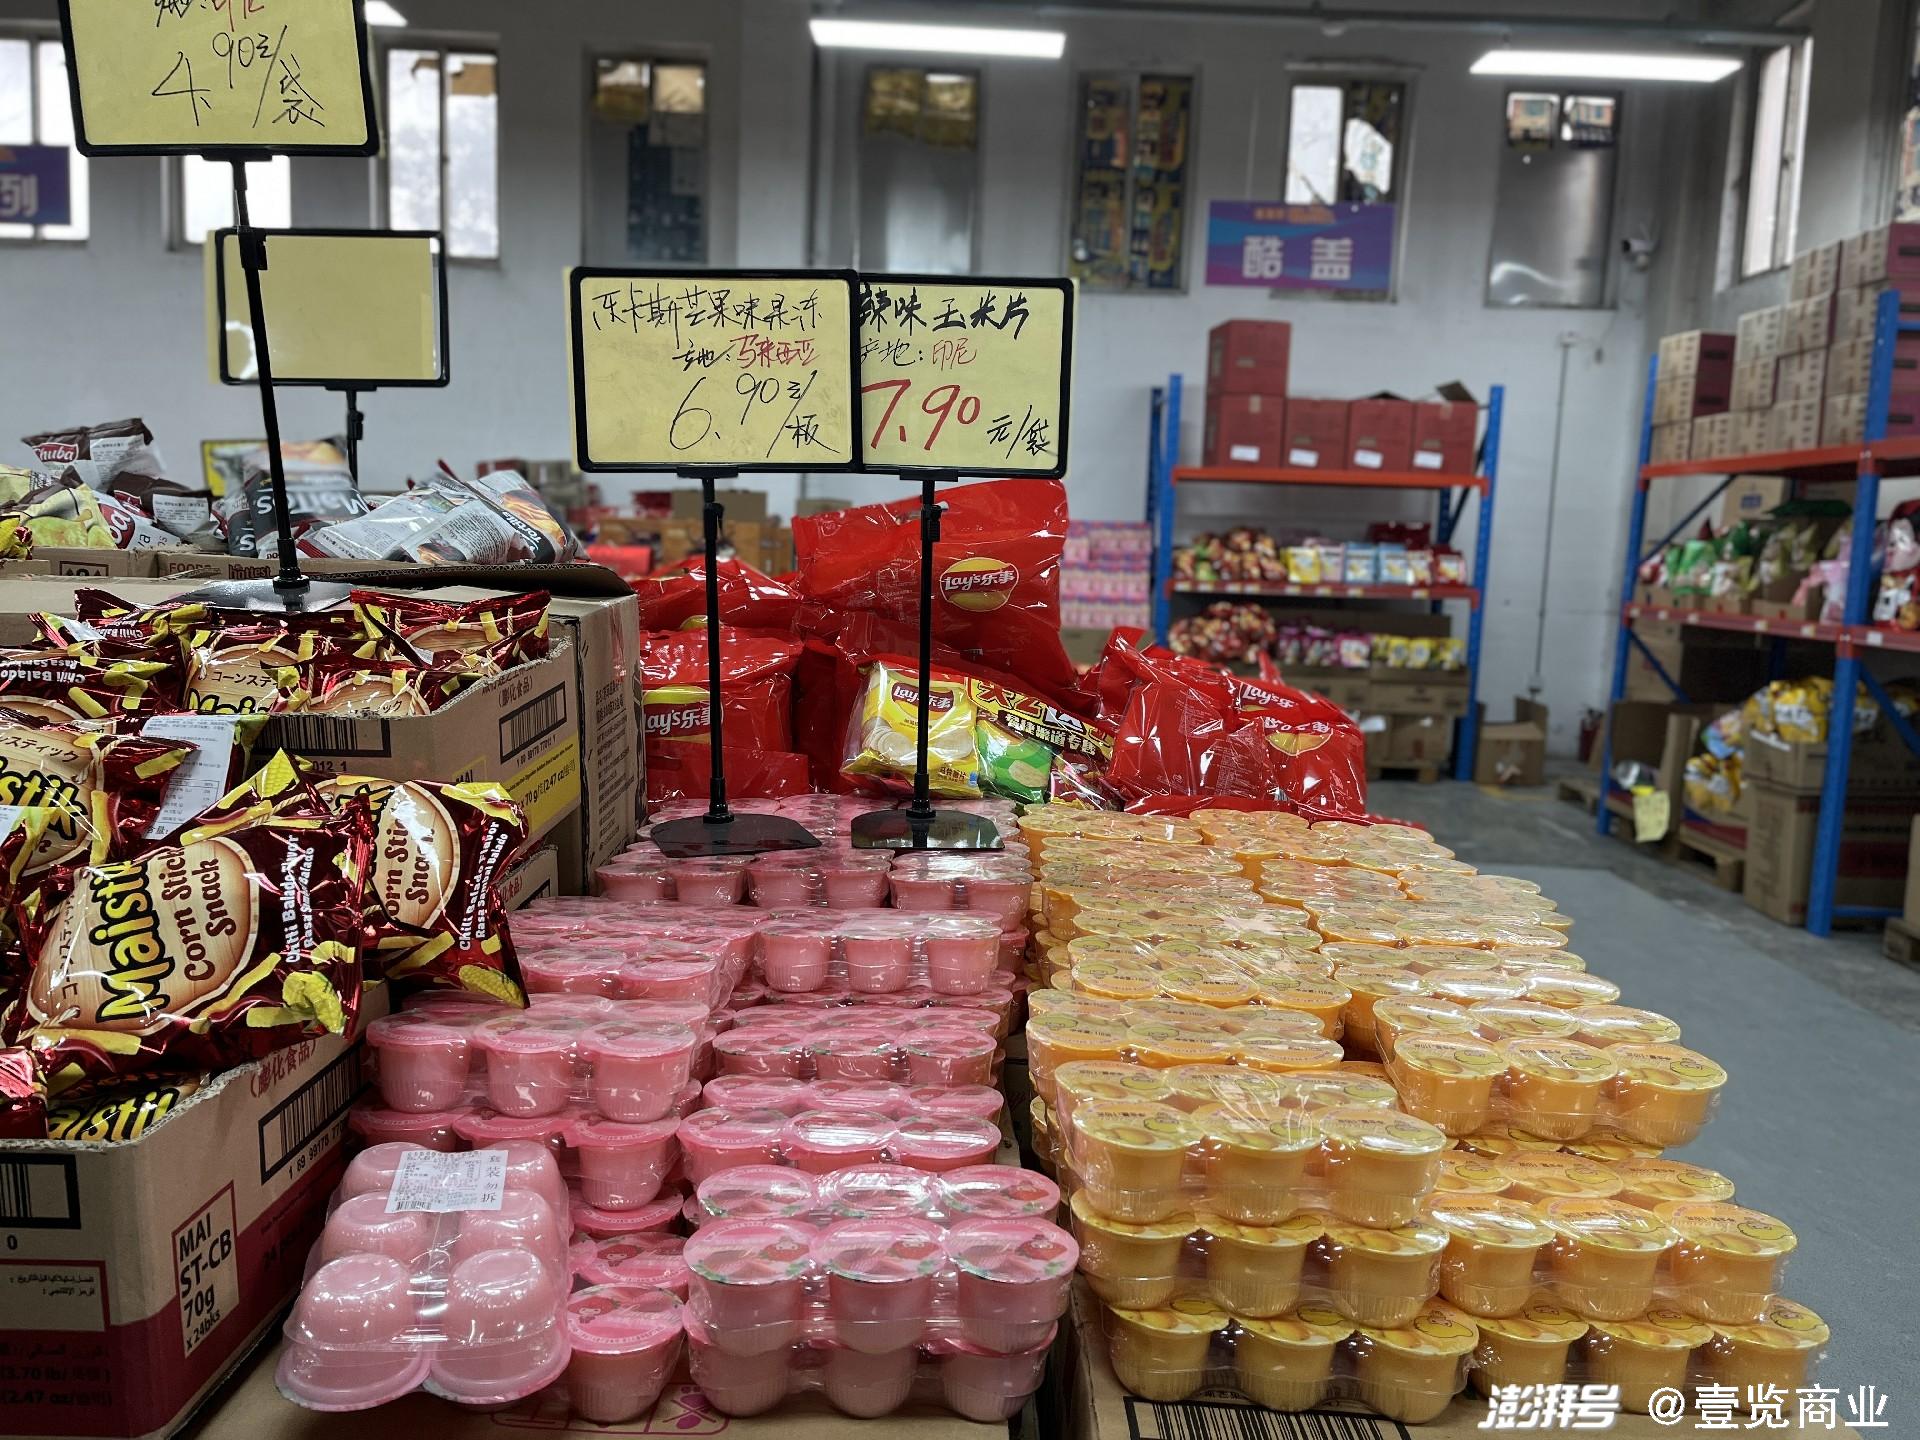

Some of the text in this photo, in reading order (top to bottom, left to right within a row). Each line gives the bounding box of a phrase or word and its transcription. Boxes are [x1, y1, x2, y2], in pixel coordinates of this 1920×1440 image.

[1243, 235, 1353, 281] 酷盖
[862, 378, 981, 451] 7.90
[157, 848, 192, 902] Stick
[192, 858, 237, 937] Snack
[383, 865, 402, 917] orn
[475, 908, 486, 939] Rasa
[487, 833, 509, 865] Balado
[174, 906, 216, 982] Corn
[459, 916, 474, 951] Chili
[7, 1235, 18, 1250] 0
[179, 1213, 212, 1263] MAI
[180, 1229, 232, 1298] ST-CB
[184, 1285, 215, 1328] 70g
